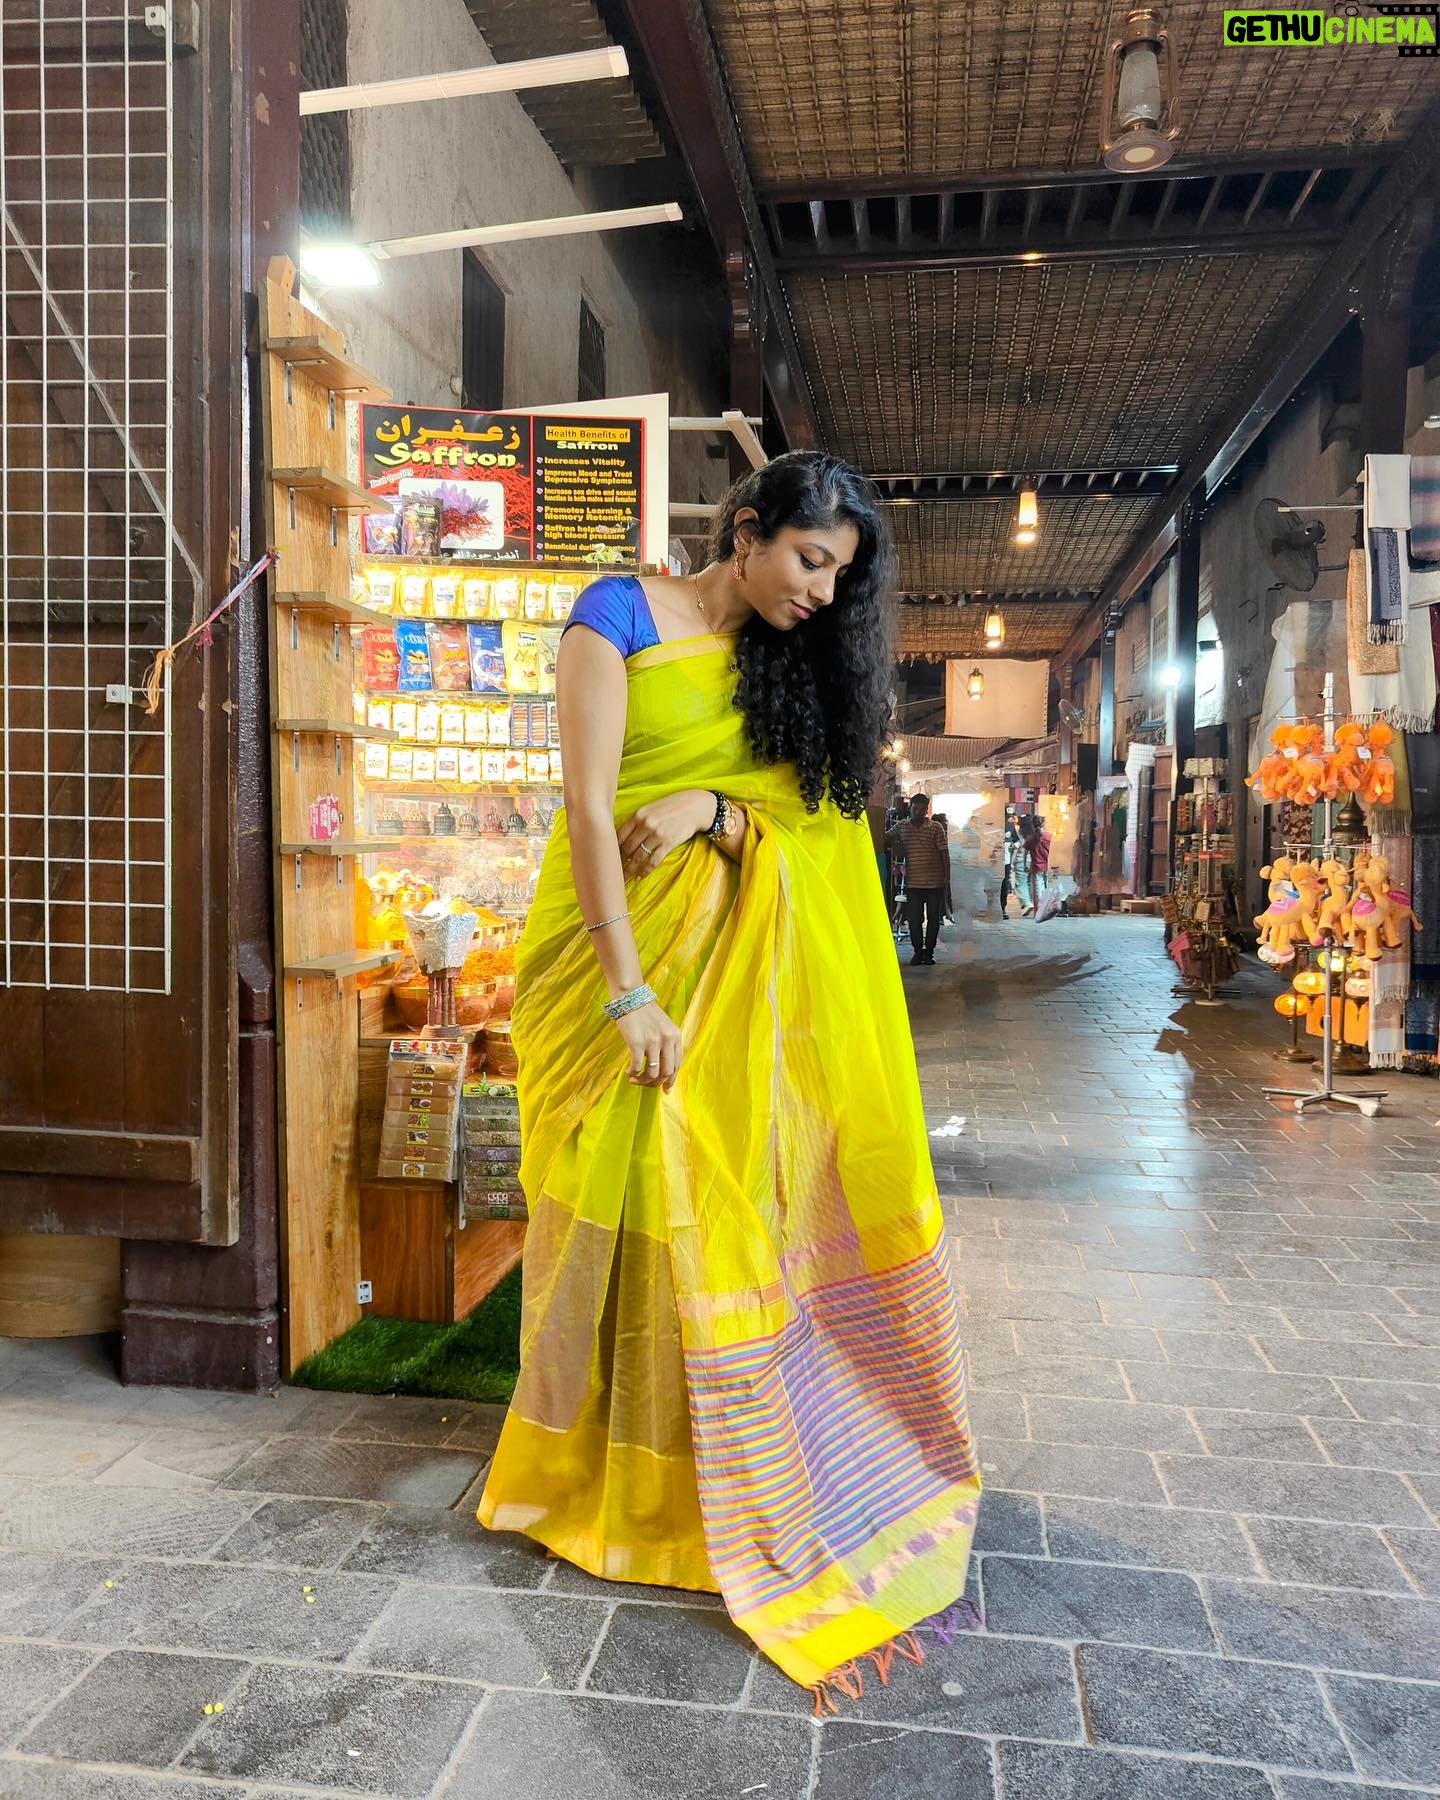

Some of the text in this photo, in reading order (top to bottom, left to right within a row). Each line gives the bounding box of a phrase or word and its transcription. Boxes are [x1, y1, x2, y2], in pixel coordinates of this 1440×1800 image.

[375, 414, 521, 450] زعفران
[547, 429, 576, 437] Health
[580, 430, 616, 438] Benefits
[557, 441, 618, 450] Saffron
[374, 443, 516, 467] Saffron
[592, 458, 626, 466] Vitality
[544, 469, 576, 477] Improves
[578, 469, 598, 477] Mood
[586, 507, 622, 515] Learning
[544, 513, 584, 521] Memory
